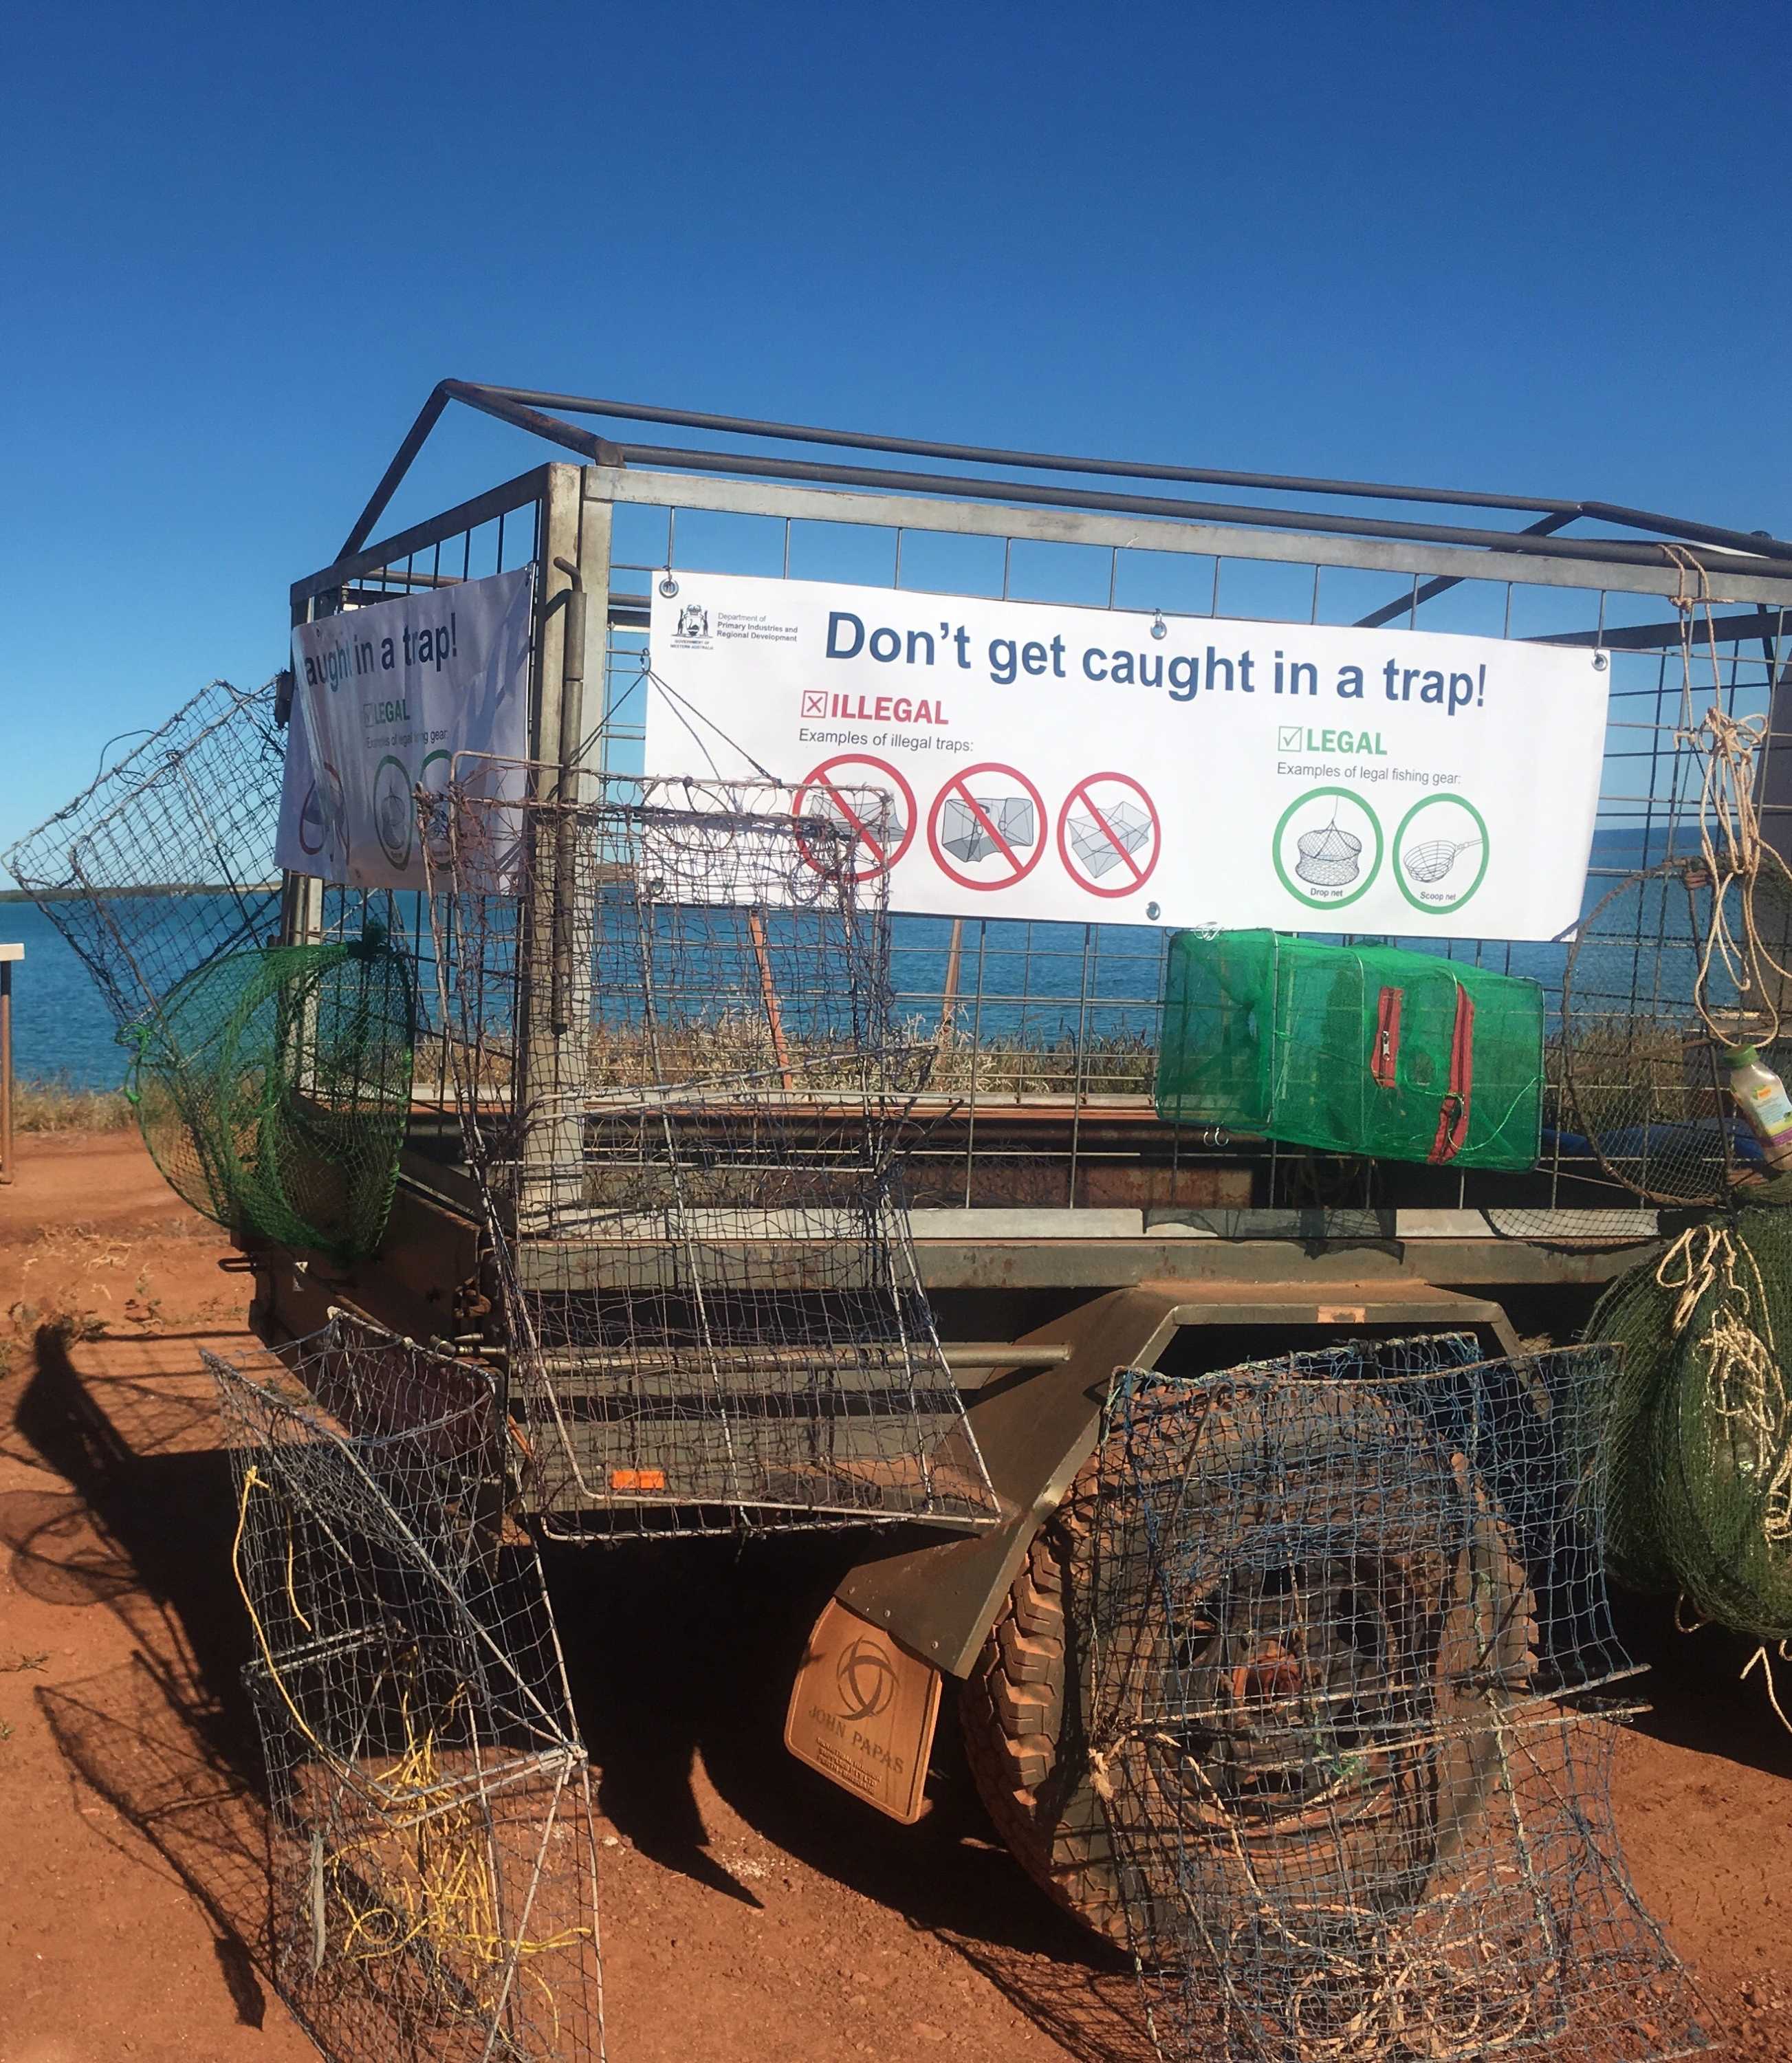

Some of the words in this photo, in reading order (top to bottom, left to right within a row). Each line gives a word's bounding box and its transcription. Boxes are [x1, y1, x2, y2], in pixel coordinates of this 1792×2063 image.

[717, 612, 757, 622] Department
[717, 621, 746, 631] Primary
[747, 623, 783, 633] Industries
[717, 630, 749, 640] Regional
[751, 632, 798, 642] Development
[304, 640, 353, 692] aught
[353, 634, 374, 675] in
[381, 637, 395, 670] a
[402, 612, 457, 672] trap!
[825, 611, 971, 670] Don't
[988, 633, 1067, 685] get
[1082, 646, 1255, 701] caught
[1274, 650, 1318, 695] in
[1336, 665, 1364, 699] a
[1382, 657, 1487, 716] trap!
[374, 699, 411, 724] LEGAL
[831, 693, 949, 725] ILLEGAL
[799, 728, 868, 746] Examples
[873, 733, 888, 746] of
[891, 734, 932, 751] illegal
[936, 737, 974, 754] traps:
[1307, 728, 1388, 756] LEGAL
[1277, 761, 1340, 778] Examples
[1344, 765, 1357, 778] of
[1360, 767, 1388, 783] legal
[1392, 768, 1429, 785] fishing
[1432, 774, 1461, 786] gear:
[1310, 888, 1329, 897] Drop
[1419, 891, 1443, 900] Scoop
[808, 1705, 846, 1738] JOHN
[852, 1730, 904, 1774] PAPAS
